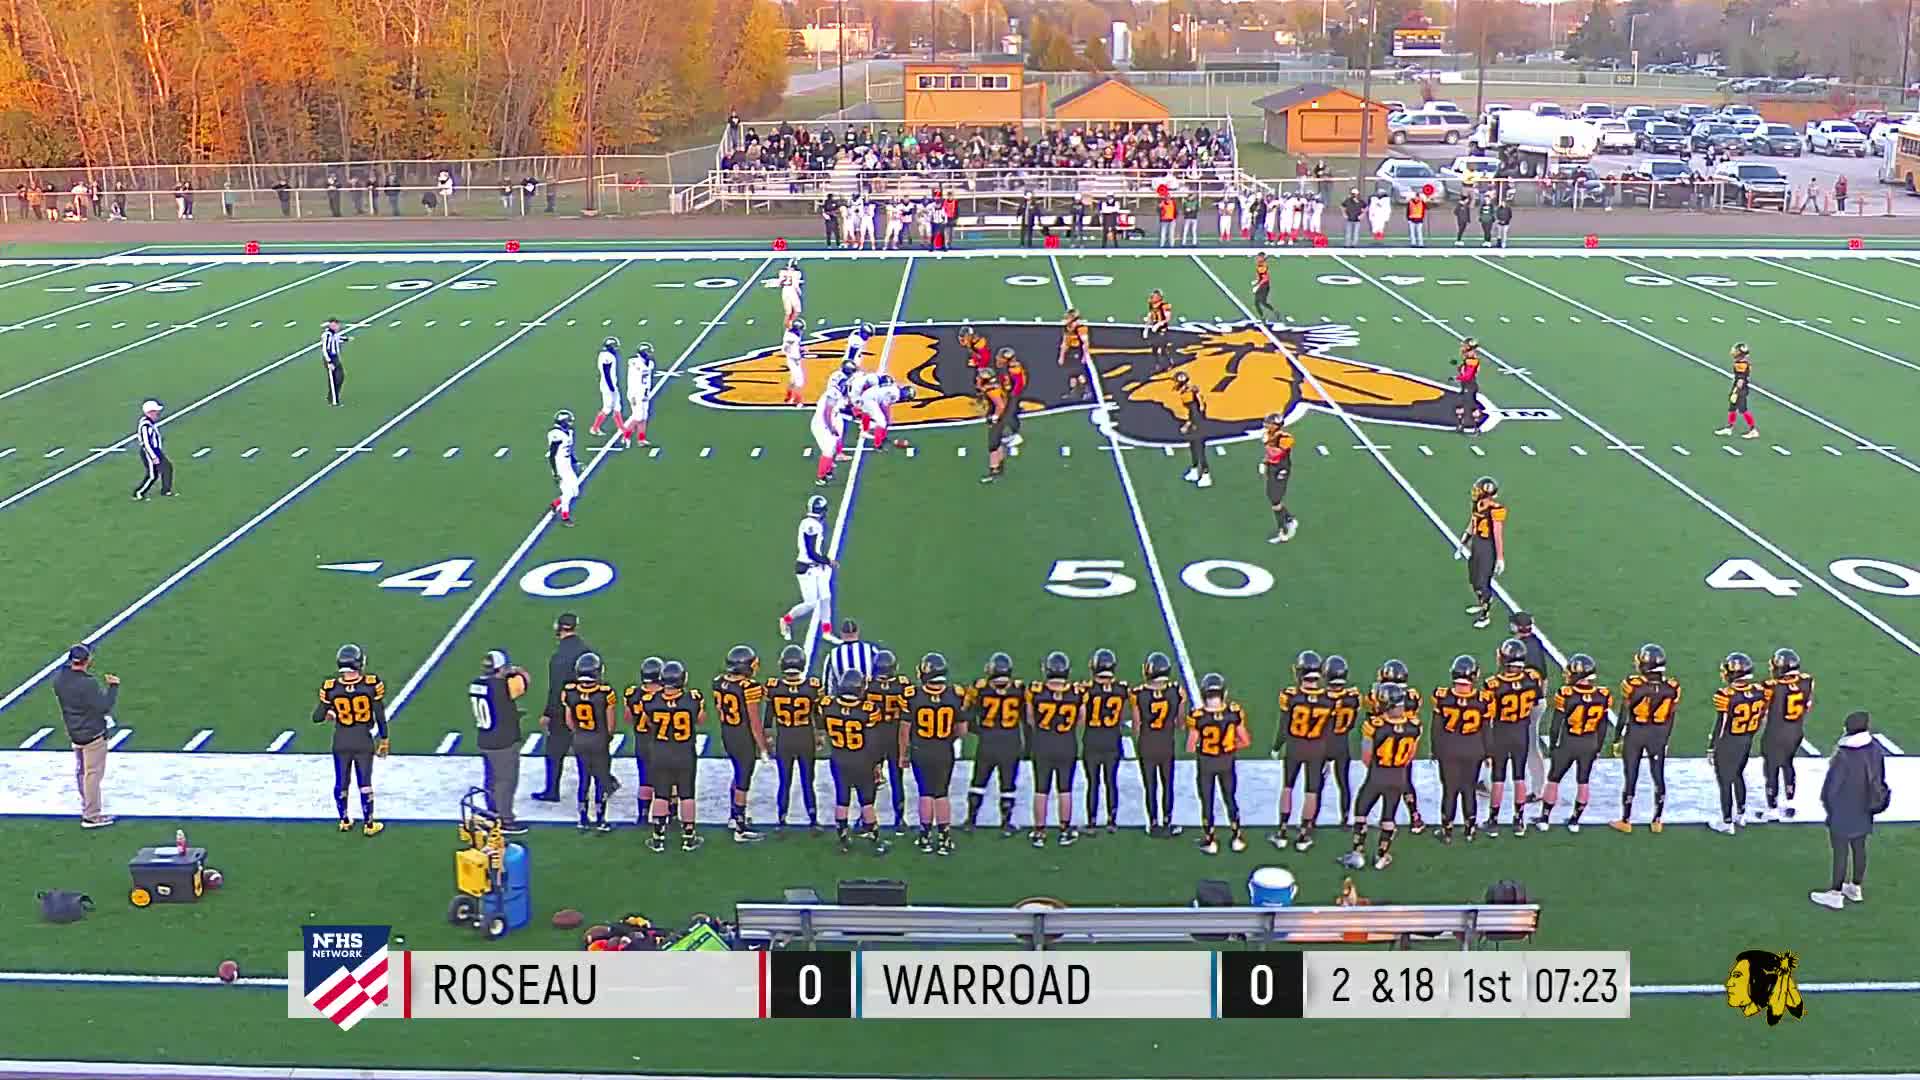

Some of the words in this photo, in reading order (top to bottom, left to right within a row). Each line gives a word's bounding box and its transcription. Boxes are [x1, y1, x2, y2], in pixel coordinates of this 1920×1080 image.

[378, 559, 614, 597] 40
[1044, 560, 1275, 598] 50
[575, 703, 596, 731] 9
[774, 697, 811, 727] 52
[982, 697, 1020, 728] 76
[1038, 703, 1076, 732] 73
[1088, 696, 1123, 727] 13
[1150, 700, 1168, 729] 7
[1442, 707, 1480, 733] 72
[1501, 689, 1537, 722] 26
[1567, 705, 1604, 735] 42
[1633, 696, 1672, 723] 44
[1731, 700, 1766, 734] 22
[1784, 692, 1804, 720] 5
[653, 711, 691, 741] 79
[826, 717, 863, 750] 56
[917, 706, 954, 738] 90
[1290, 705, 1330, 738] 87
[1201, 723, 1236, 756] 24
[1376, 736, 1417, 767] 40
